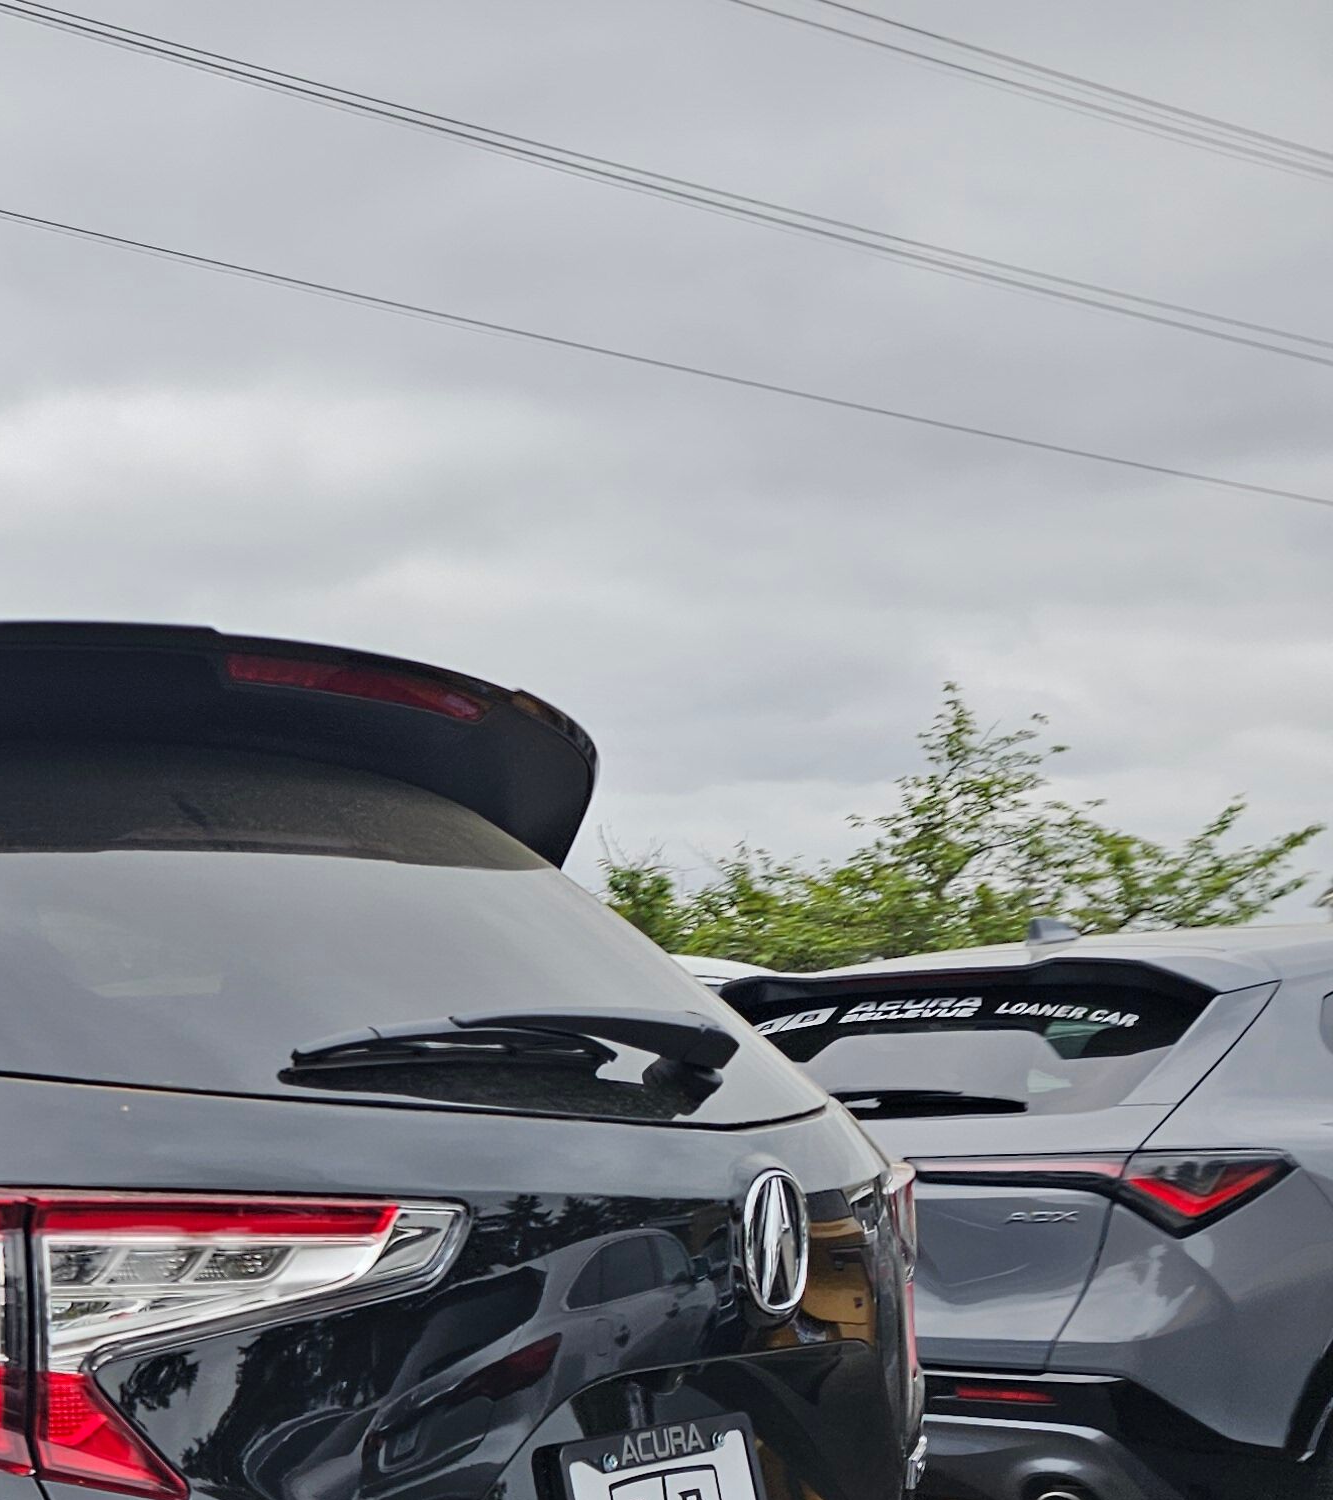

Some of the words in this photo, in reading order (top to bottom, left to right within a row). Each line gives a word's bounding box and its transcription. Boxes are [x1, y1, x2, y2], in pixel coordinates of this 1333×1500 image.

[837, 1008, 979, 1024] BELLEVUE
[845, 997, 983, 1014] ACURA
[994, 1002, 1088, 1019] LOANER
[1087, 1009, 1140, 1027] CAR
[622, 1423, 706, 1466] ACURA
